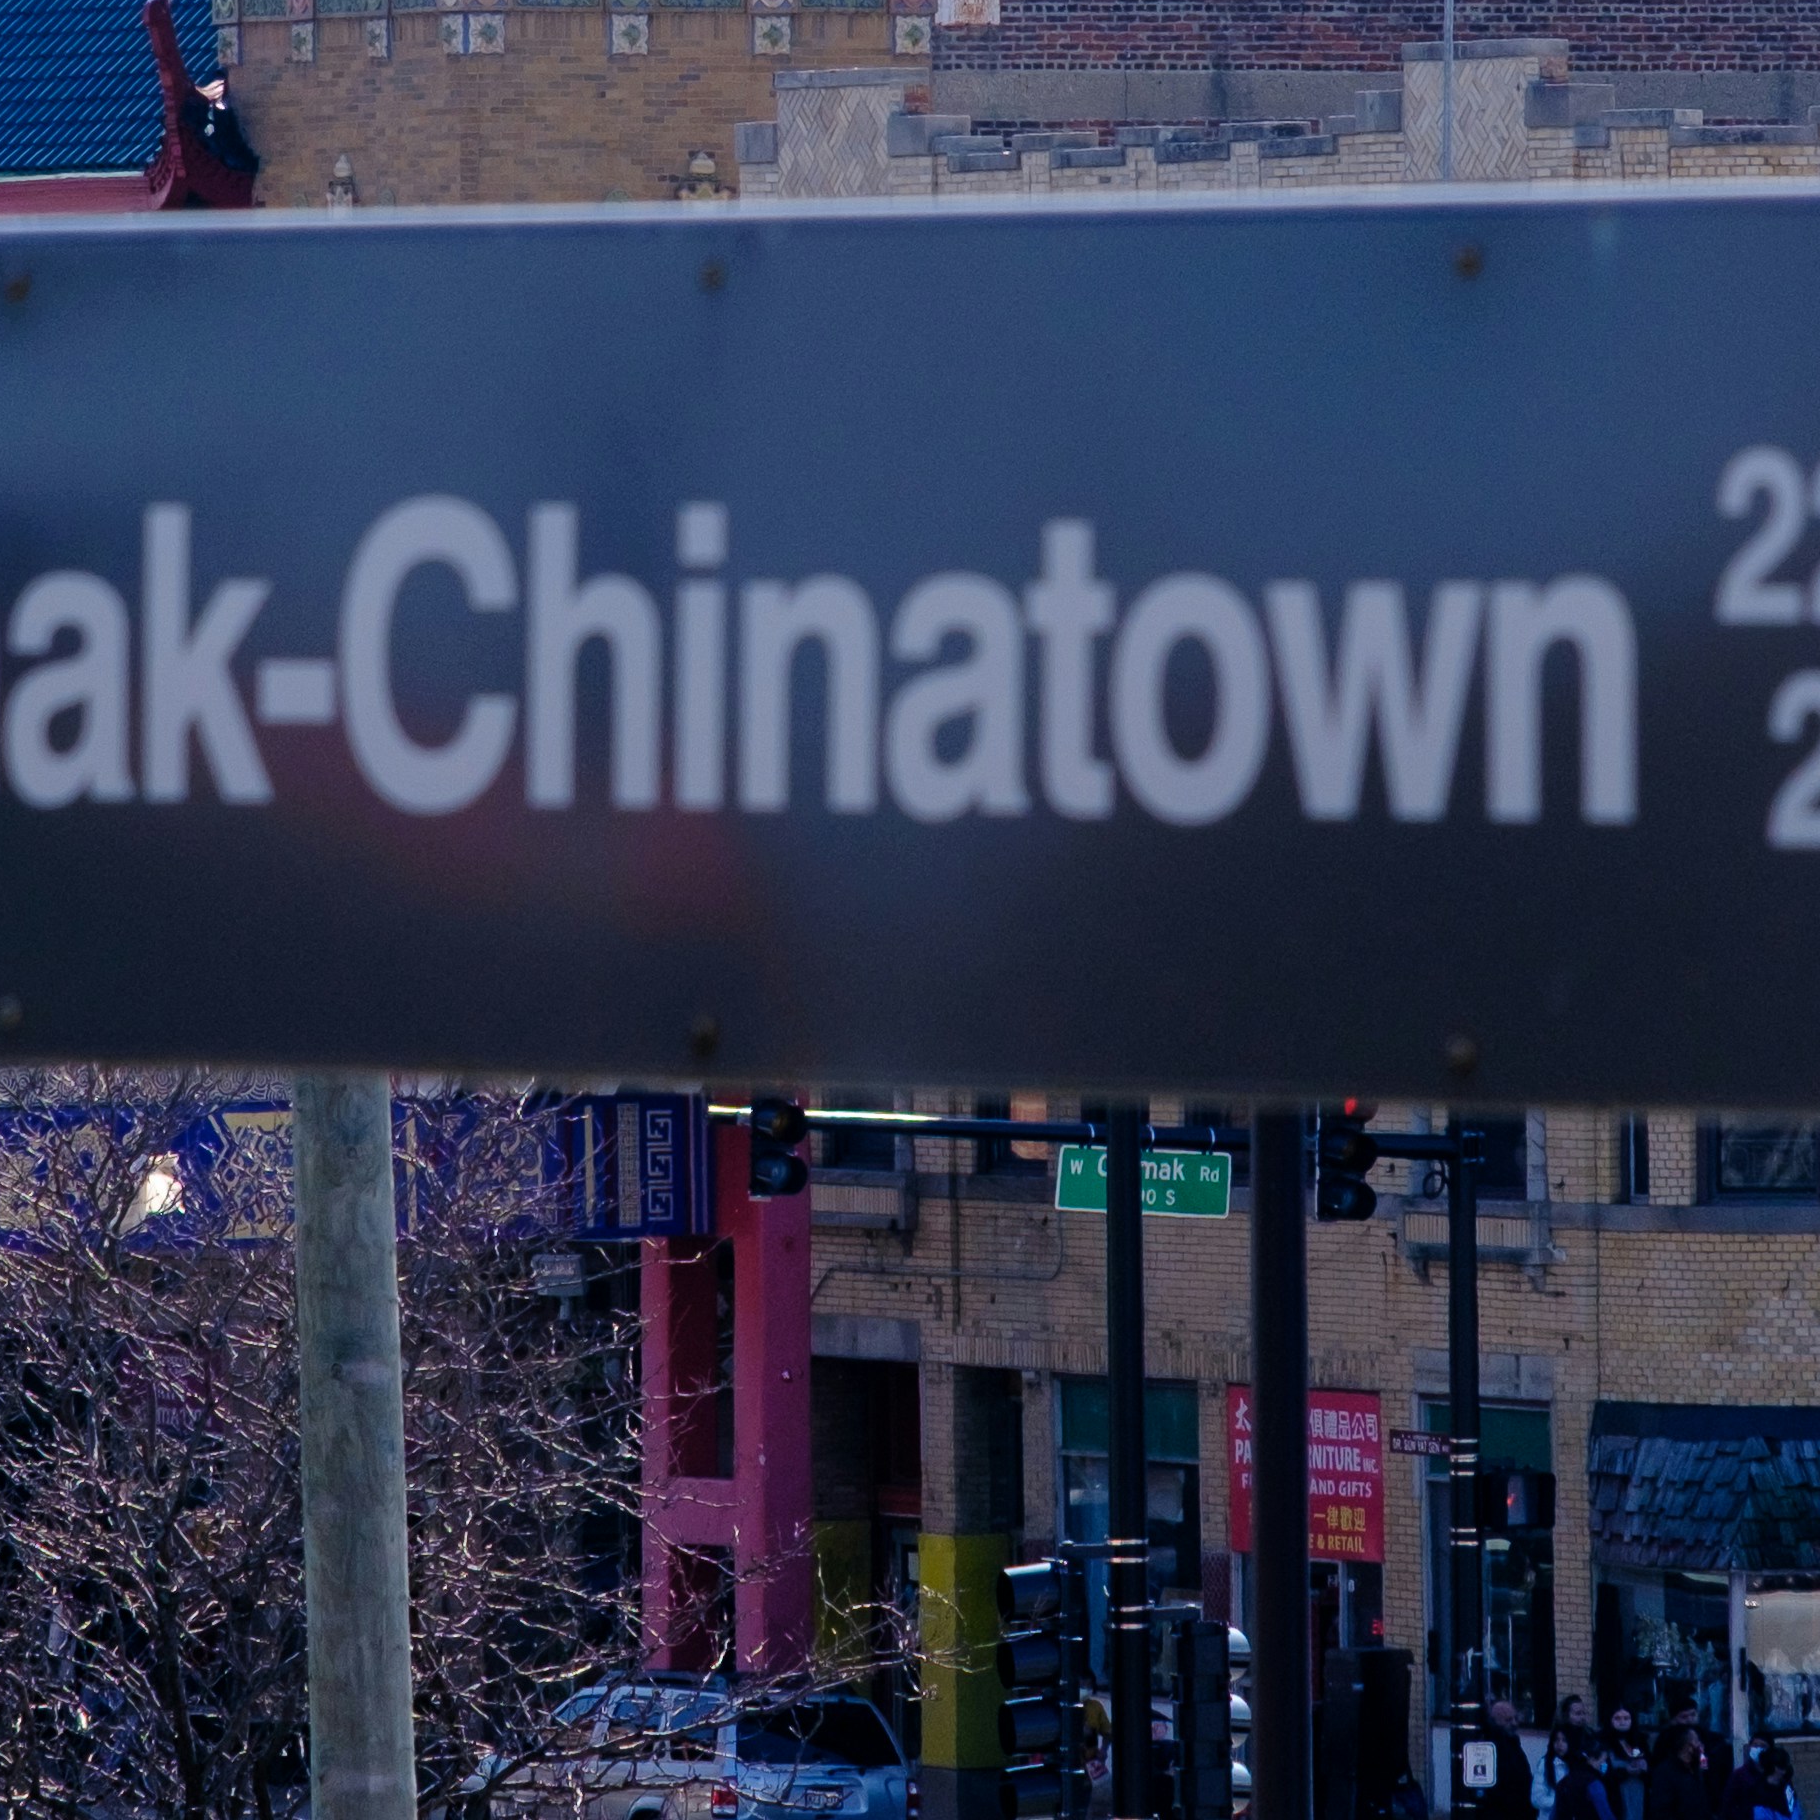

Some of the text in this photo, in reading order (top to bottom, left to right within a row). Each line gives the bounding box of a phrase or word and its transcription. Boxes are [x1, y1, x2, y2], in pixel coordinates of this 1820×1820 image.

[1070, 1153, 1220, 1183] W Cmak Rd
[1165, 1189, 1176, 1206] S
[1310, 1477, 1373, 1498] AND GIFTS
[1316, 1536, 1325, 1550] &
[1327, 1534, 1366, 1553] RETAIL
